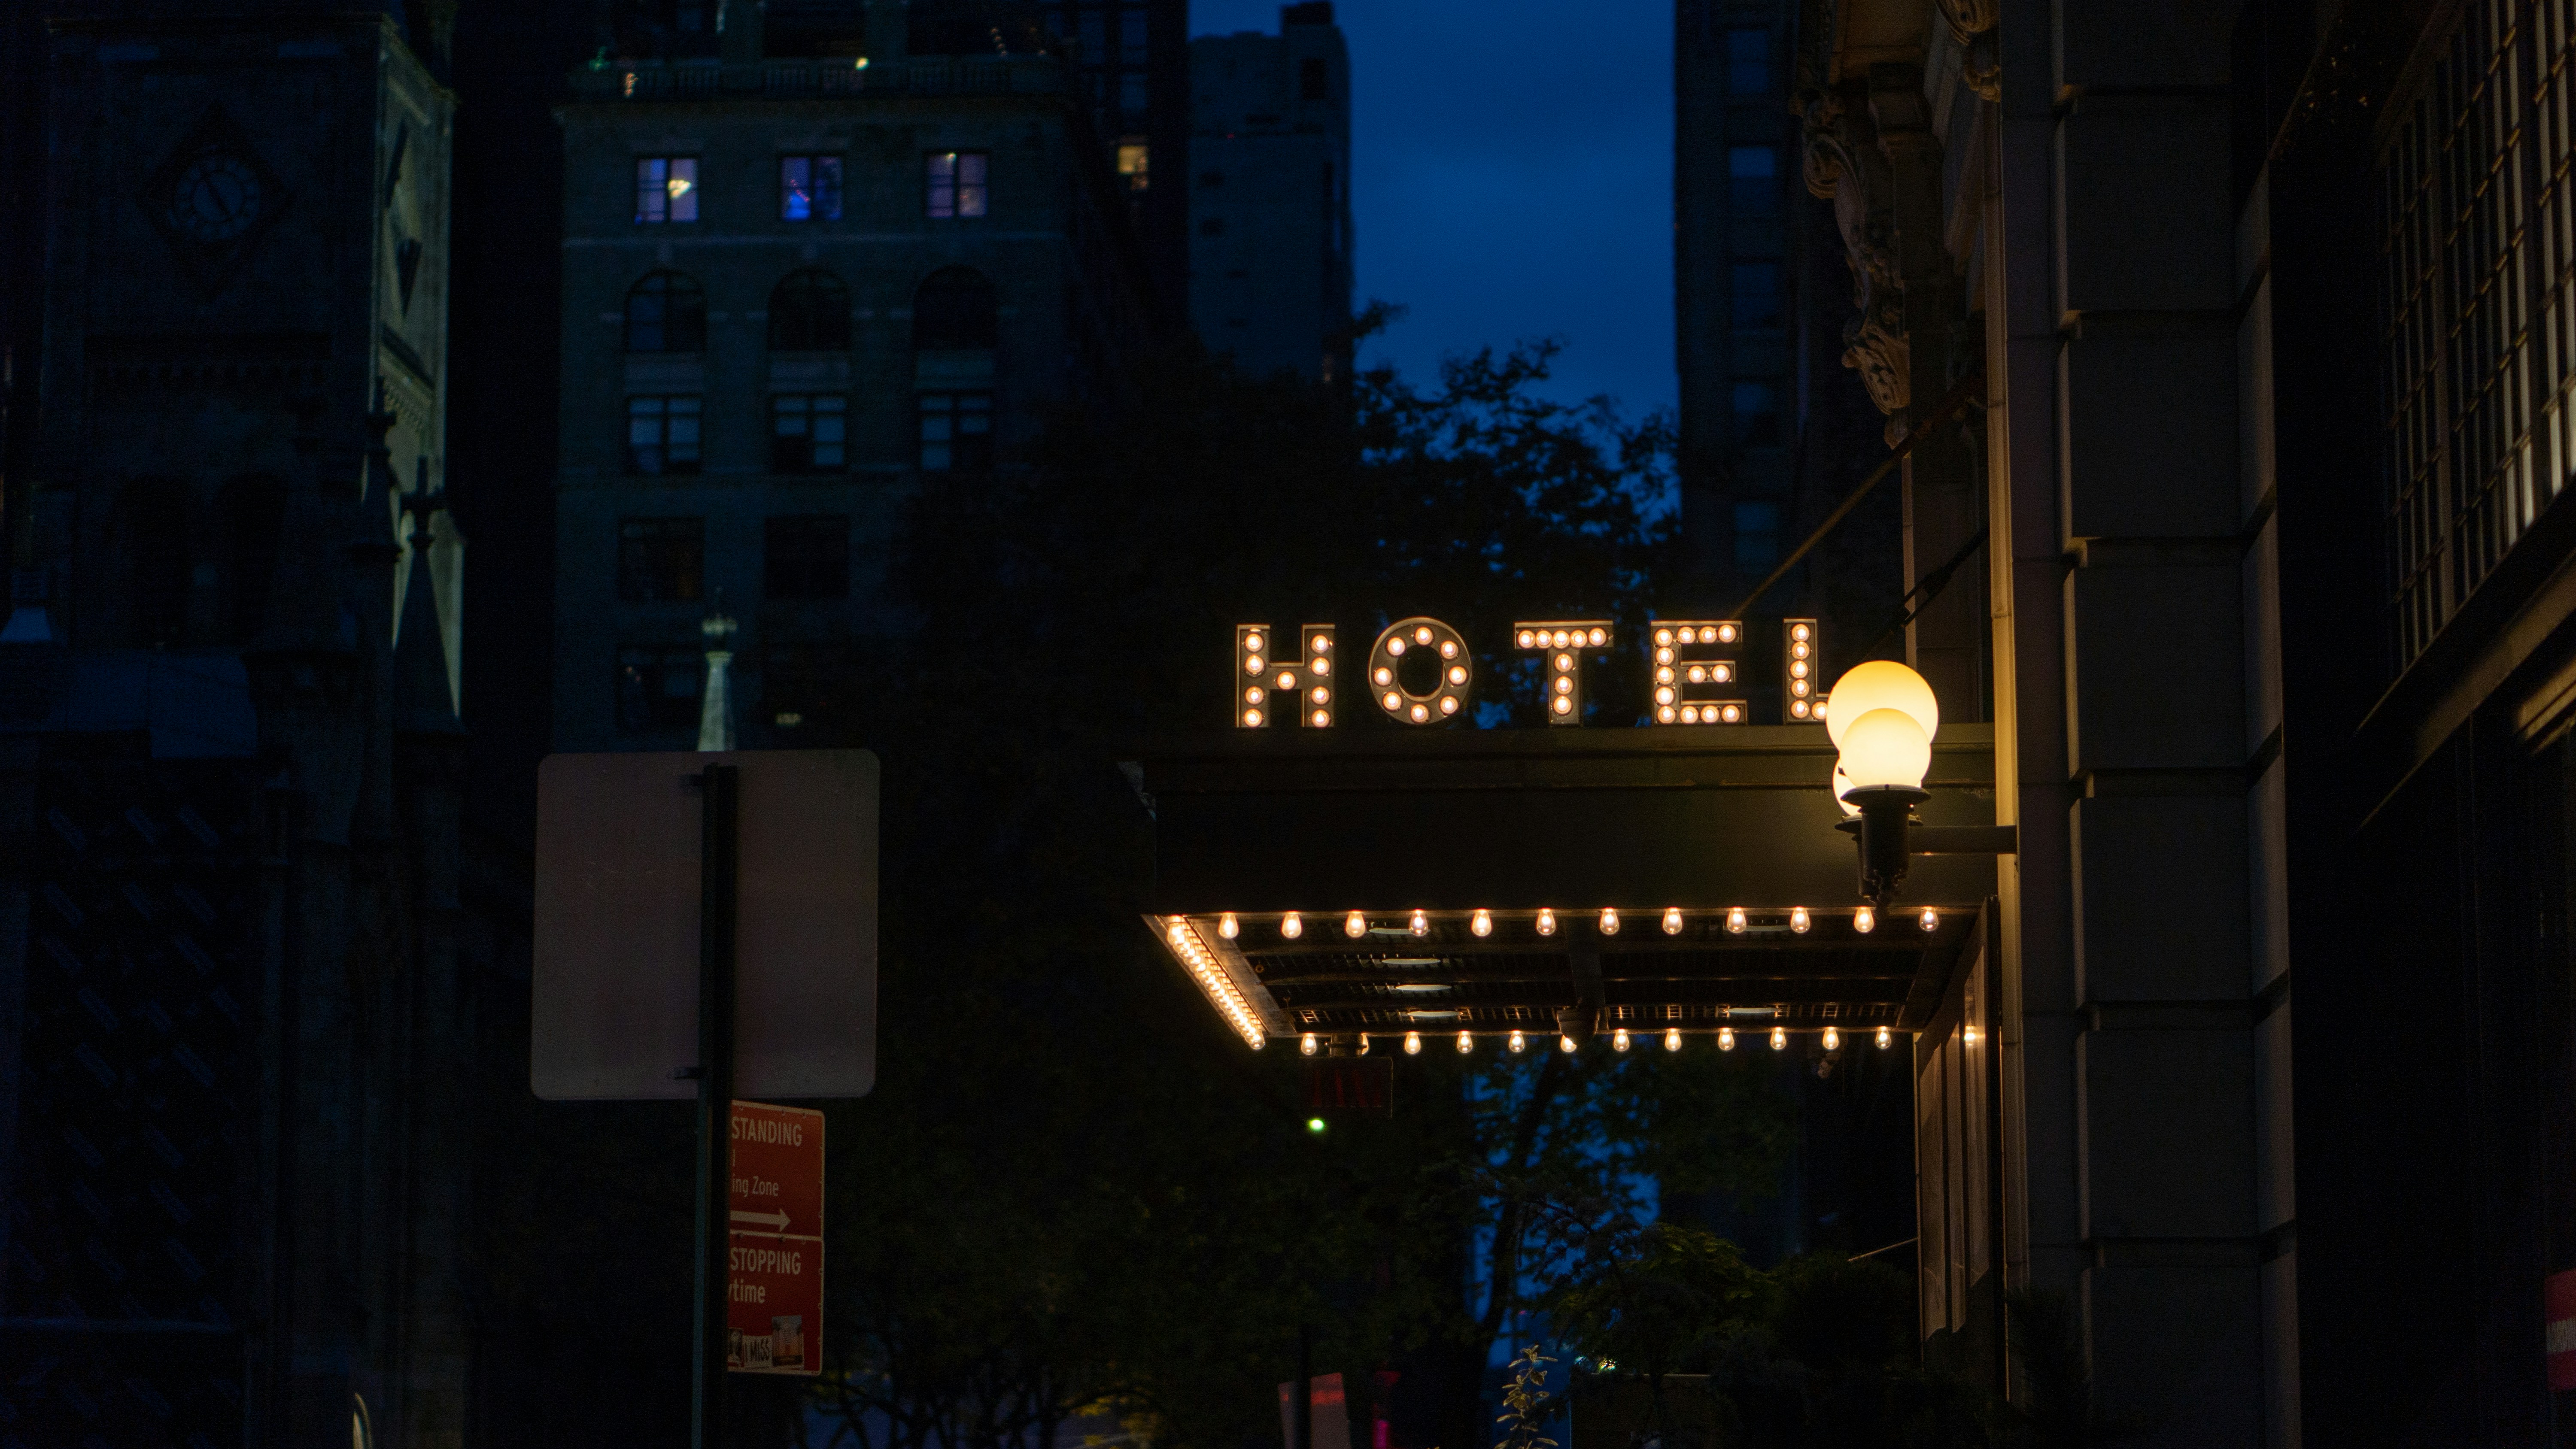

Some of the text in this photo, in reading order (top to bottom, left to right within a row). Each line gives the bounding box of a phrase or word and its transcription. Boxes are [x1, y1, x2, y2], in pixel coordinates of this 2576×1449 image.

[1236, 616, 1830, 727] HOTEL
[731, 1116, 802, 1147] STANDING
[752, 1176, 779, 1197] Zone
[730, 1247, 801, 1275] STOPPING
